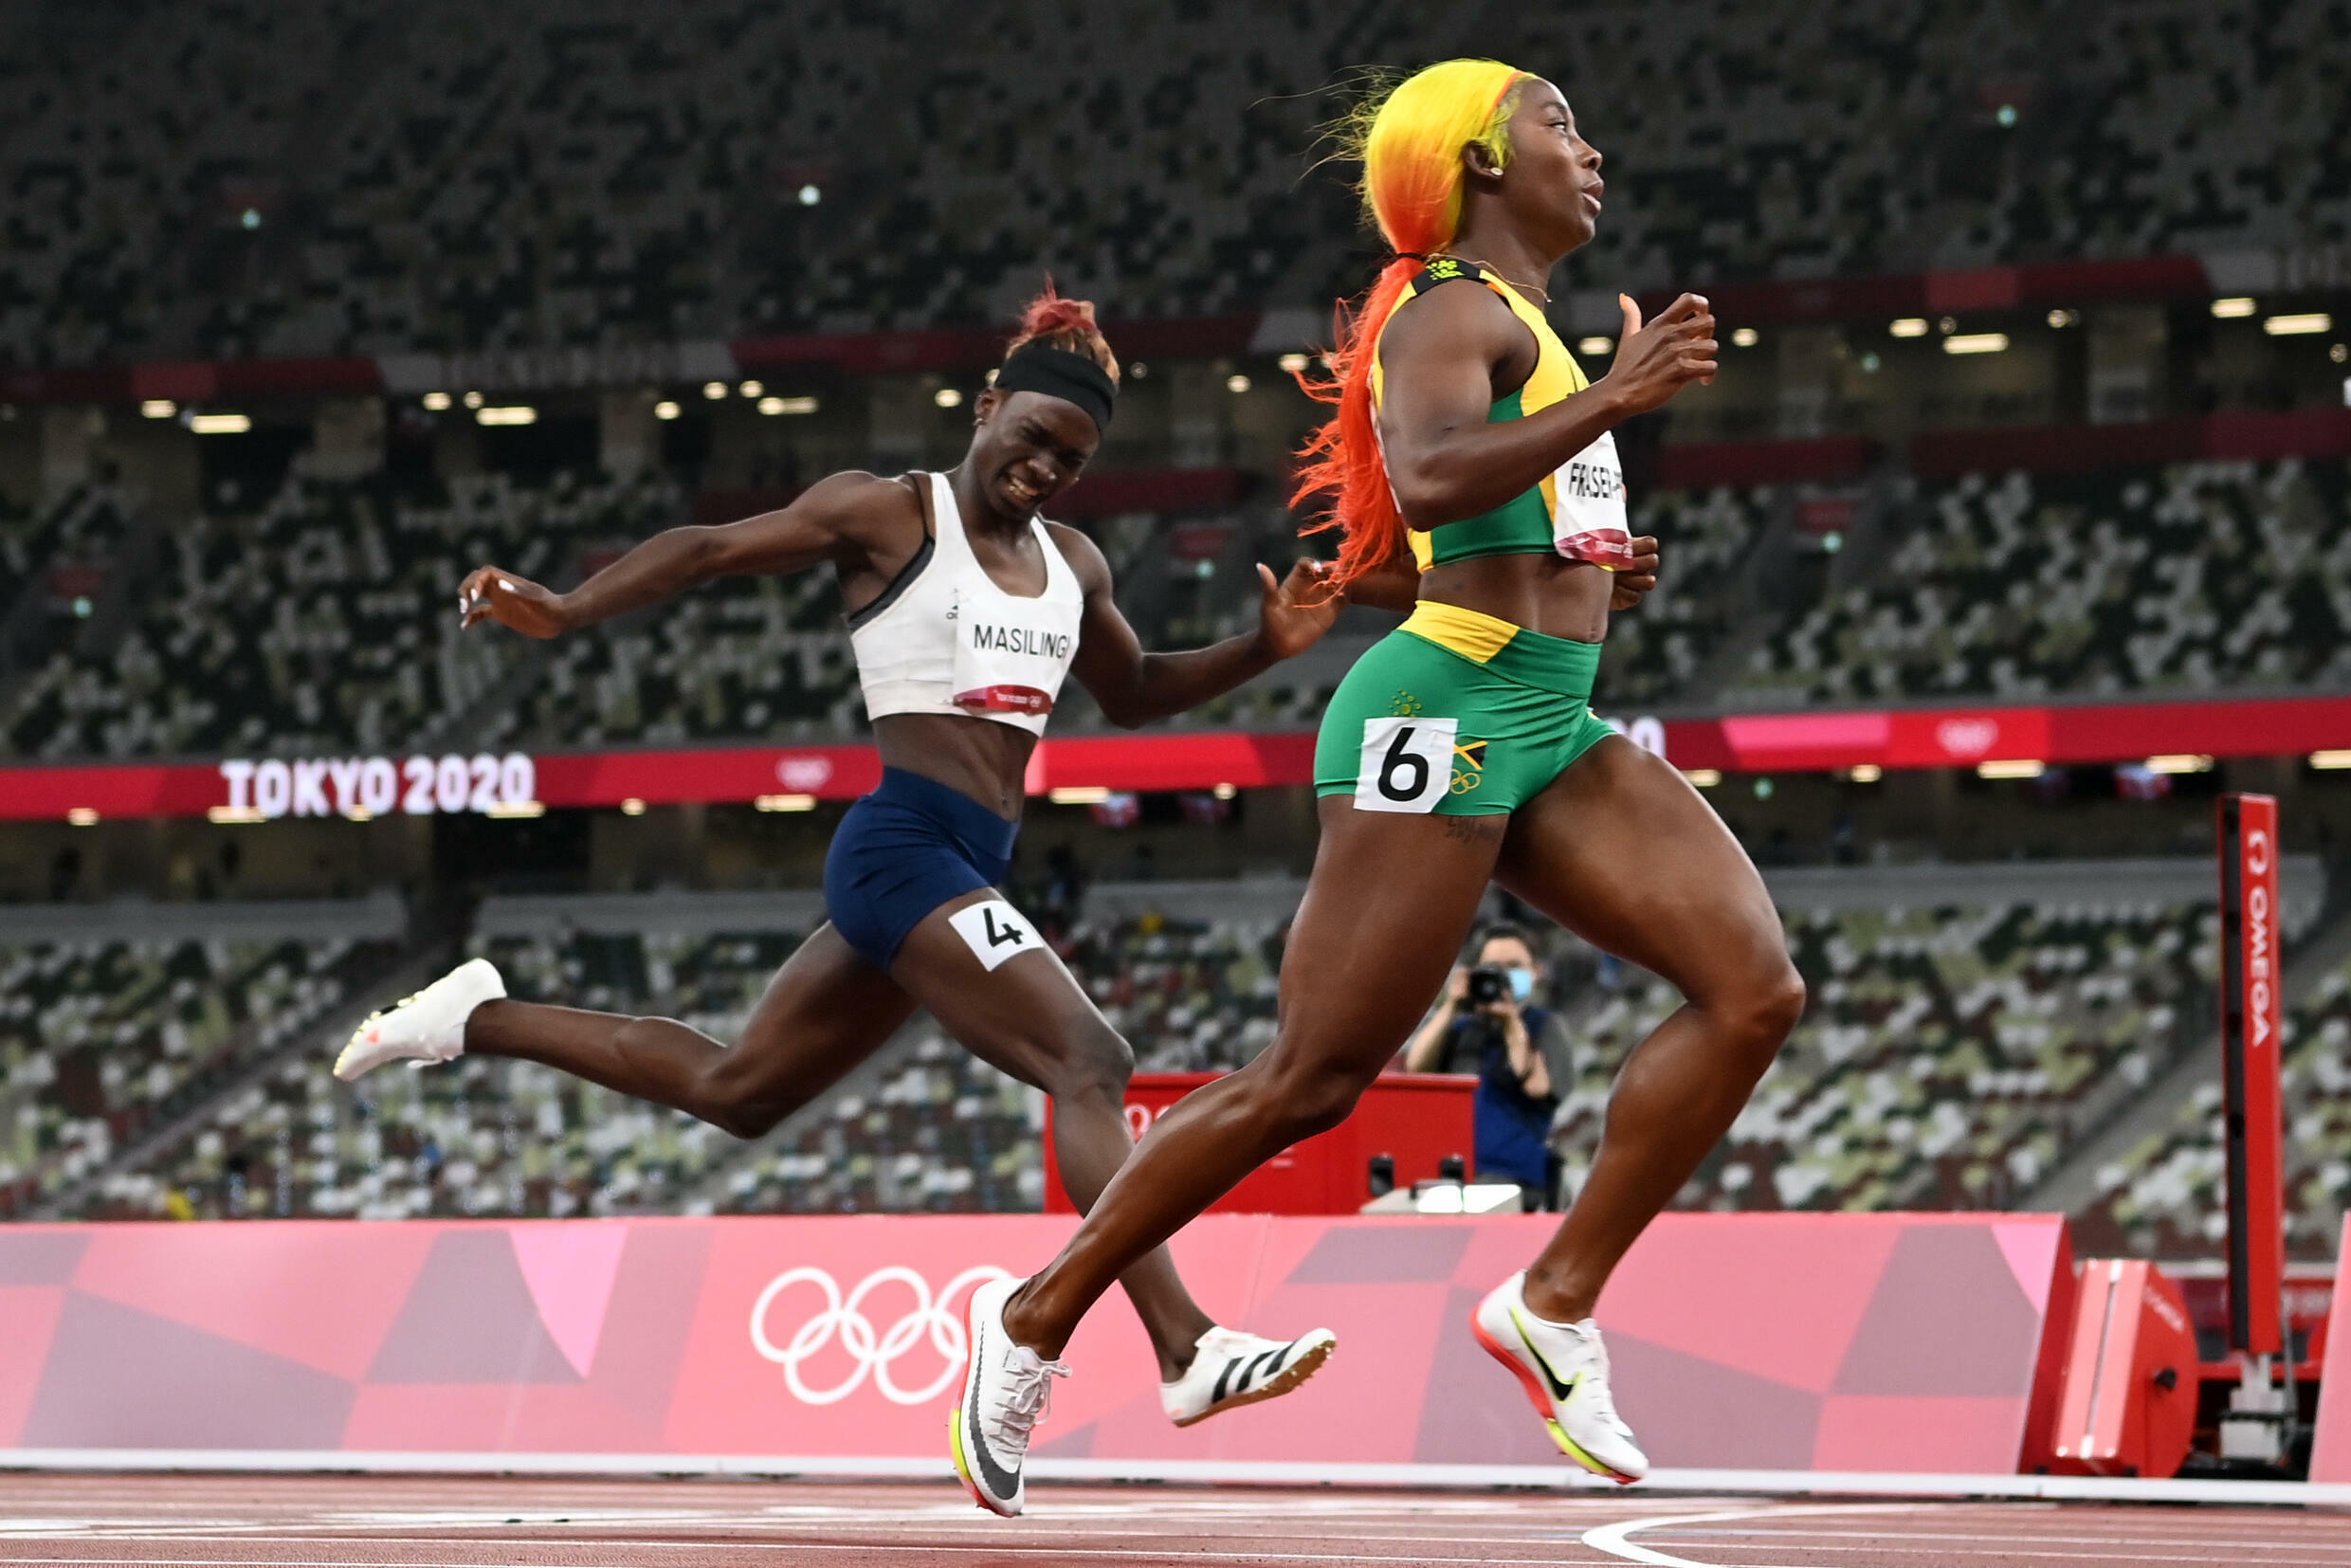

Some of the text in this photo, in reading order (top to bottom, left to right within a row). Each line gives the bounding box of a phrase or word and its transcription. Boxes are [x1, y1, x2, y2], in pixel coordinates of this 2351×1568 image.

[221, 752, 536, 819] TOKYO 2020
[1377, 727, 1429, 802] 6
[983, 907, 1024, 948] 4
[2249, 885, 2270, 1048] OMEGA
